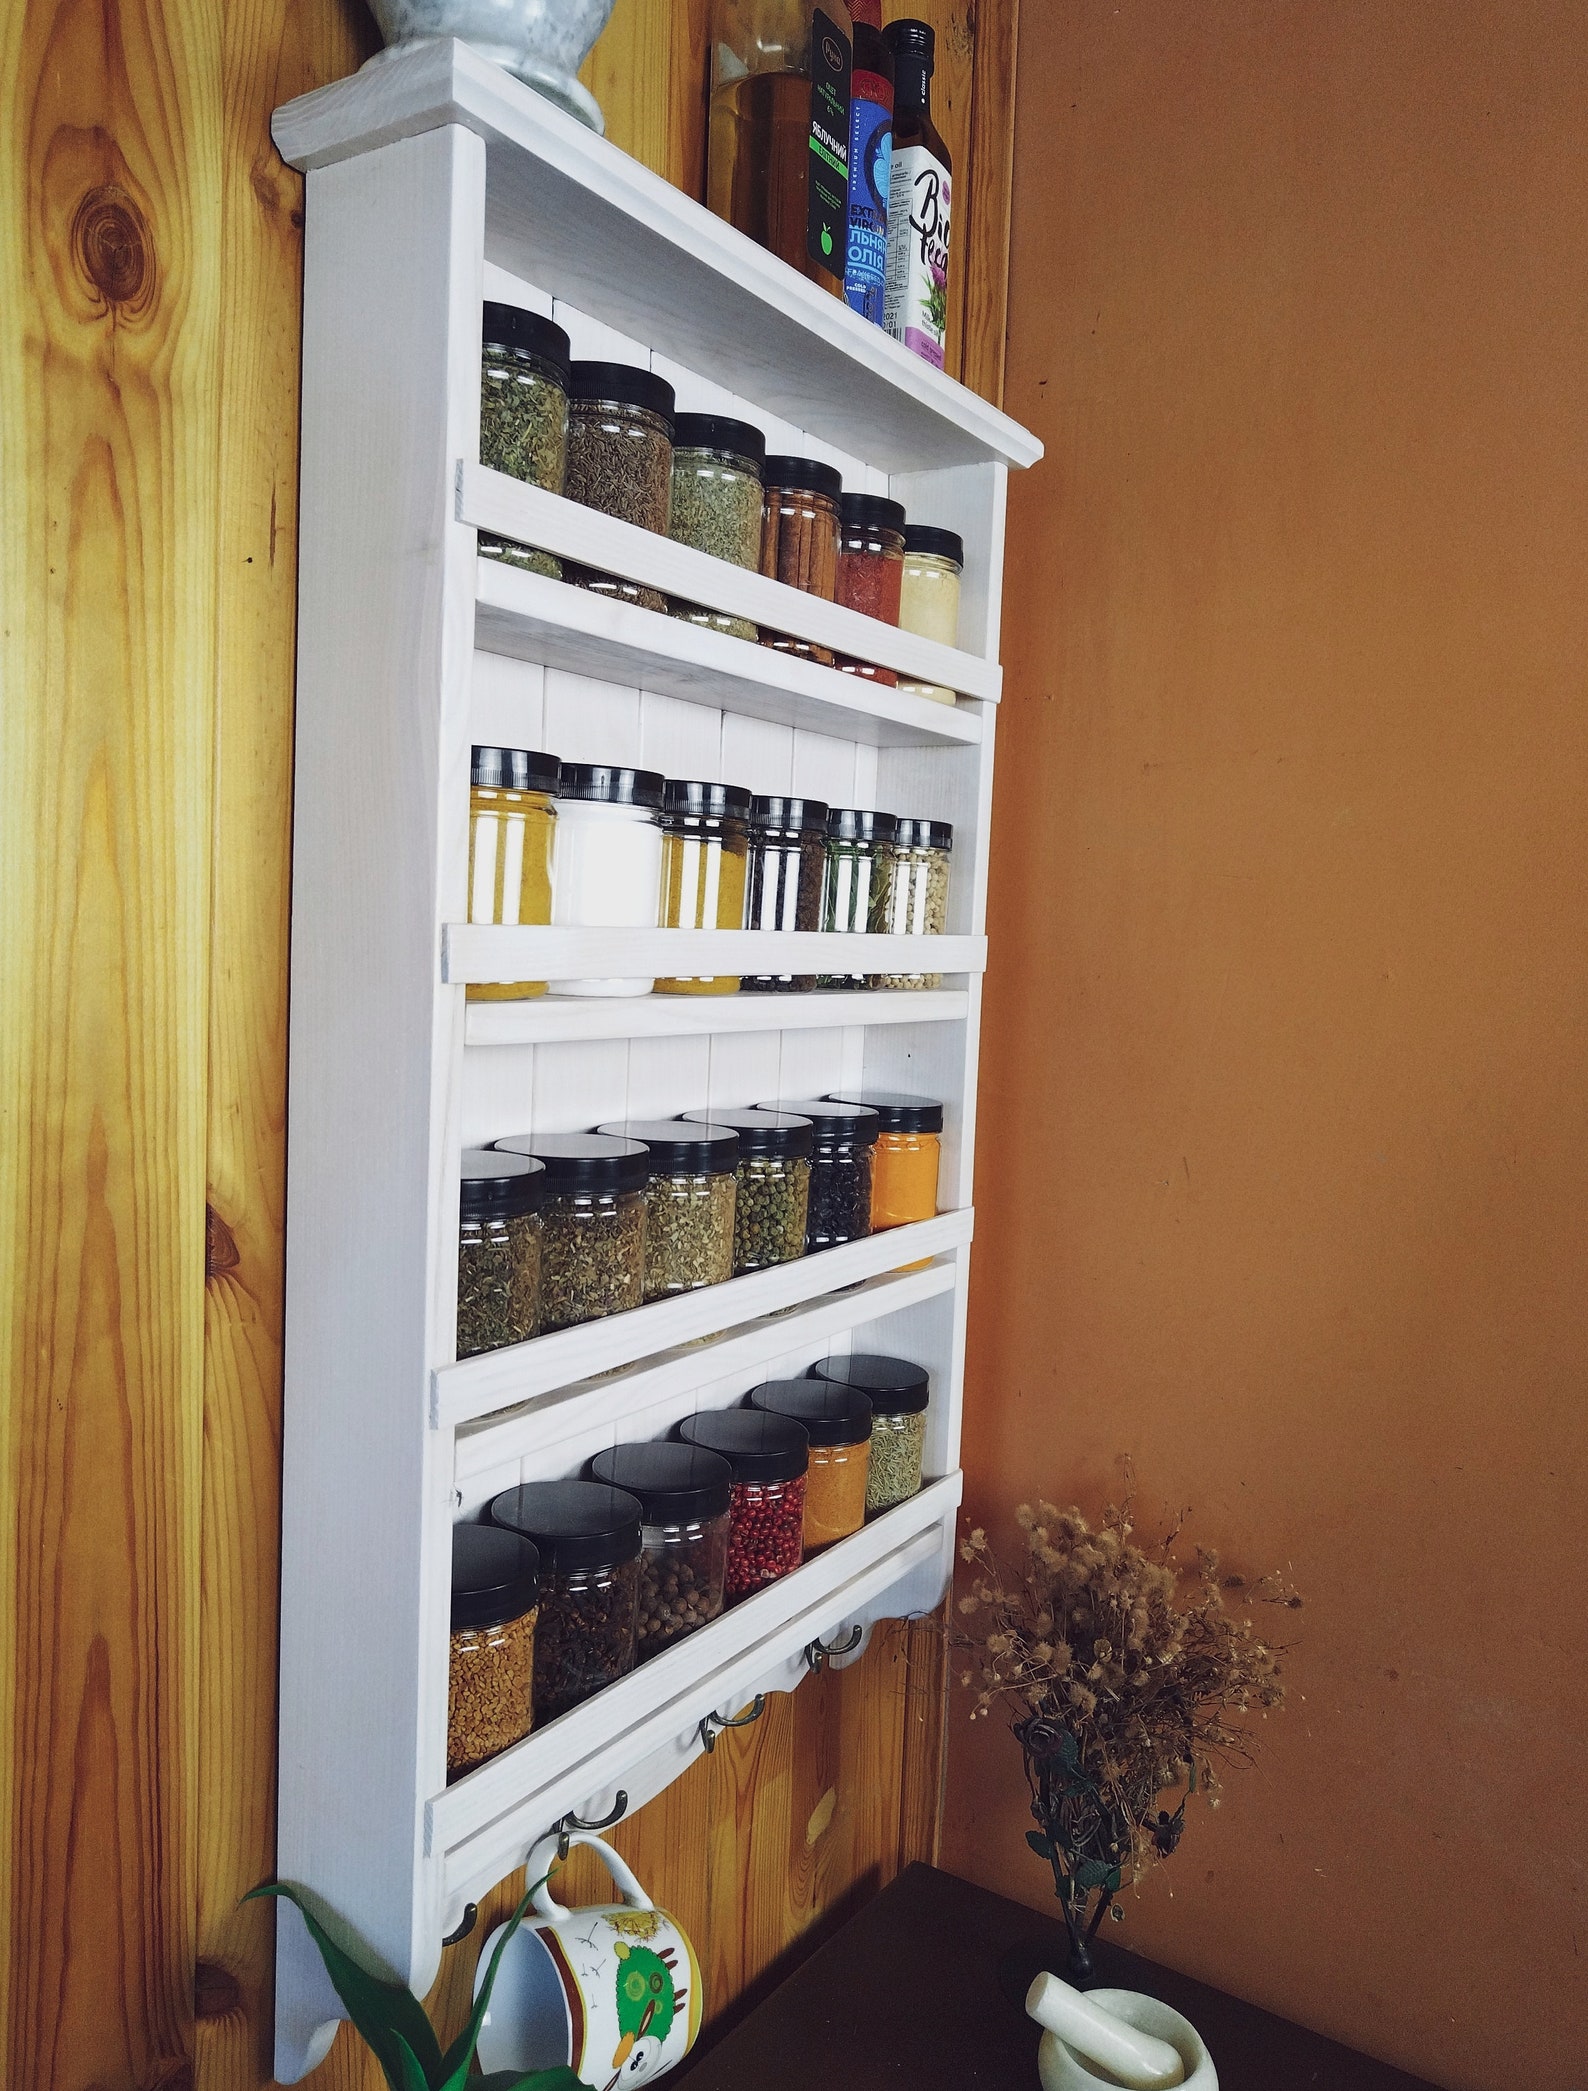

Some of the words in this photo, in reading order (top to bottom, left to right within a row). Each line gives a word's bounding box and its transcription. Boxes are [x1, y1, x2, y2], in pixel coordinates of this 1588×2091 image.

[811, 120, 847, 163] ЯБЛУЧНИЙ
[851, 147, 859, 191] PREMIUM
[847, 245, 884, 271] ОЛІЯ
